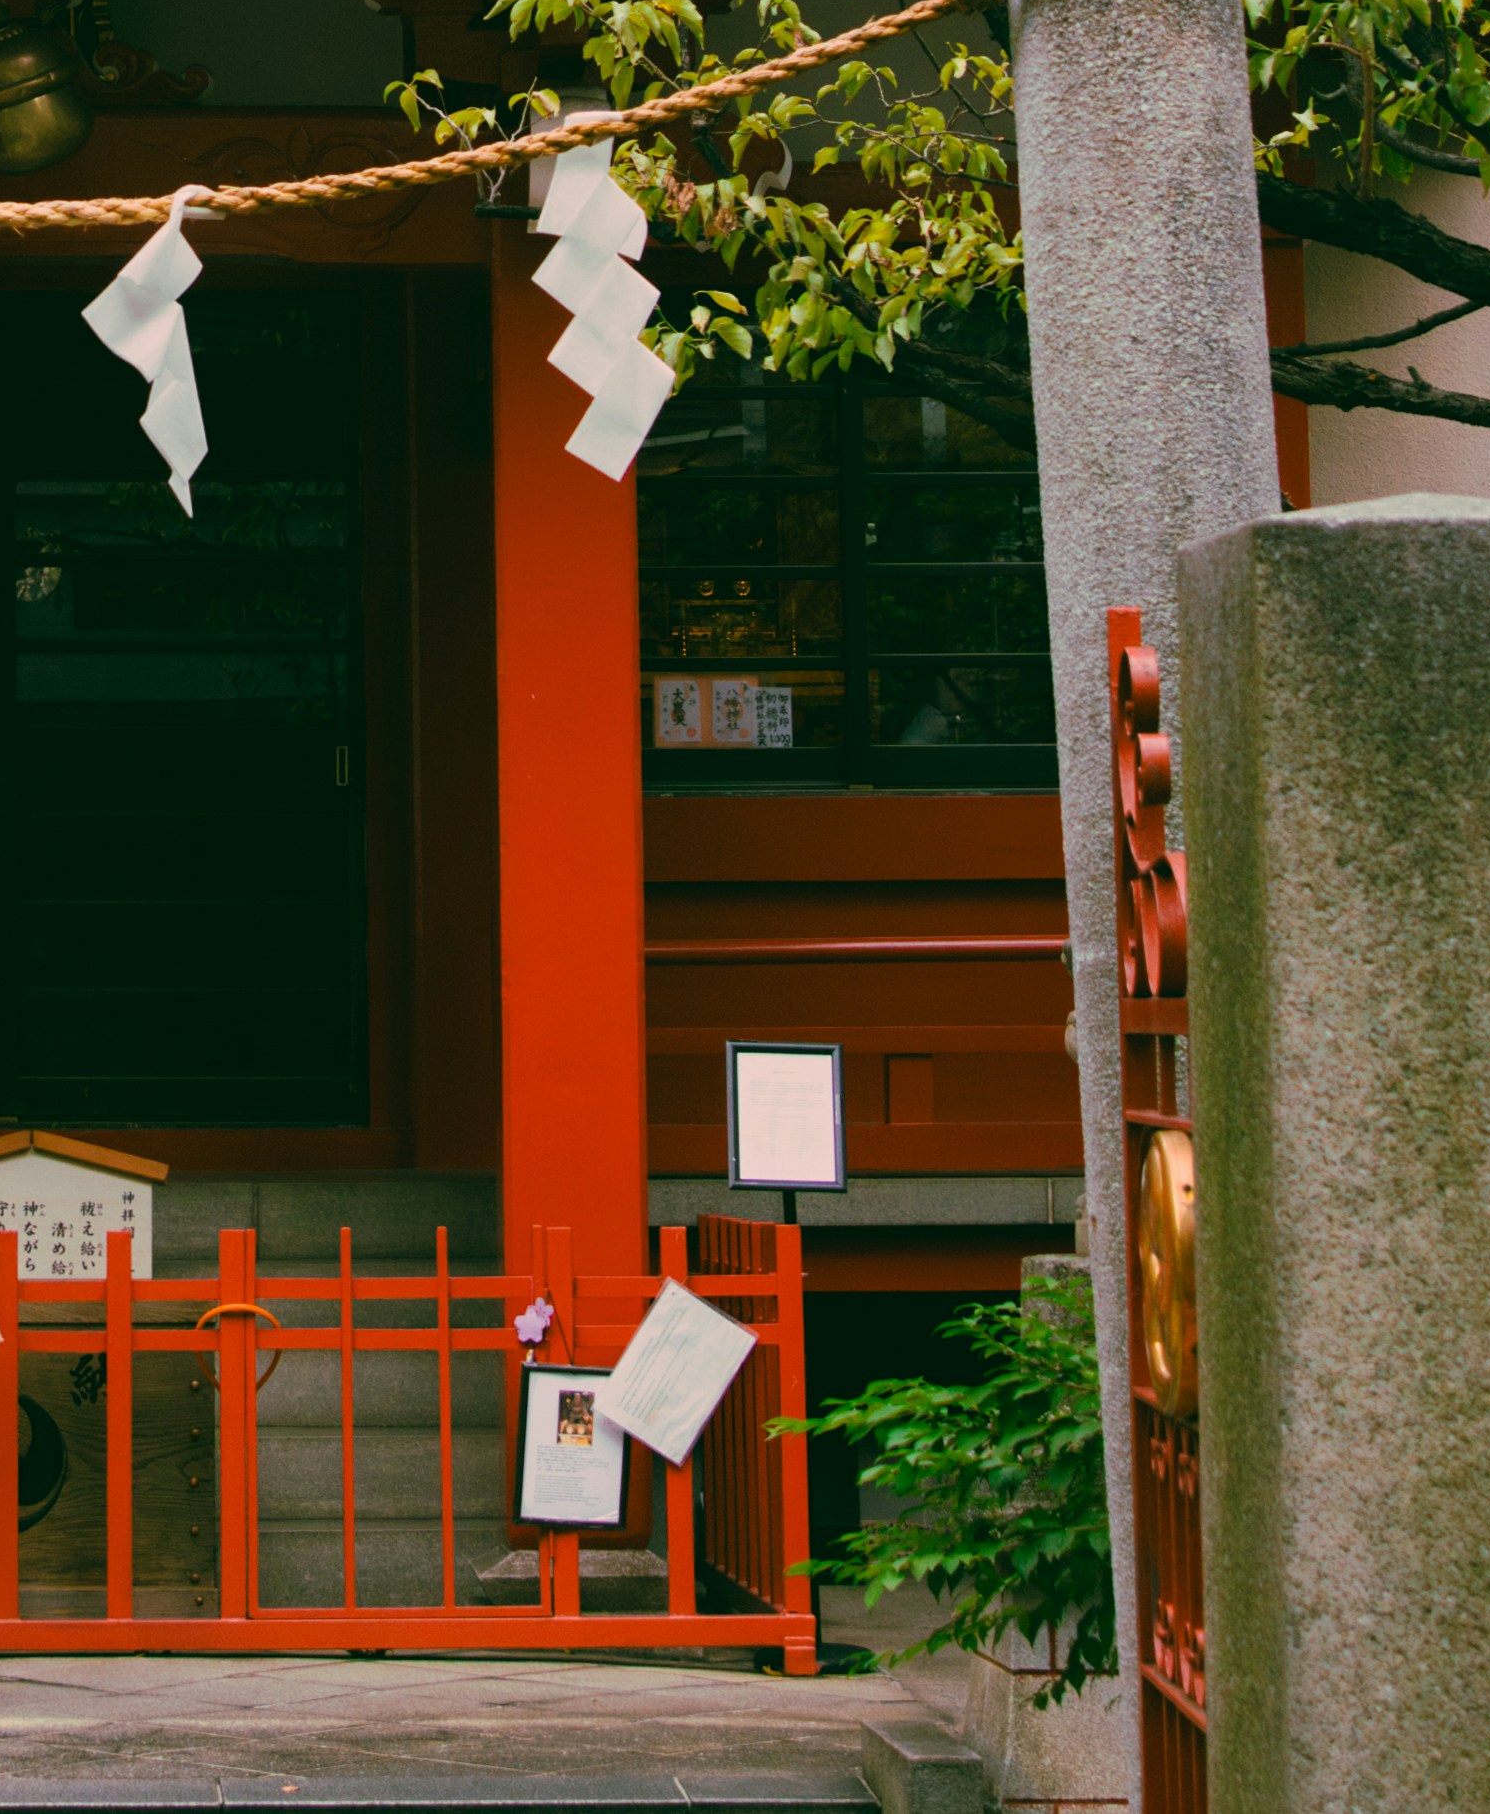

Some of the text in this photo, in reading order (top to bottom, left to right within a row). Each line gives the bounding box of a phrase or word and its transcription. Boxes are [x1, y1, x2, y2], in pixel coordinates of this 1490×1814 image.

[724, 688, 740, 730] 八幡神社
[23, 1201, 38, 1272] 神ながら
[80, 1201, 96, 1271] 祓え給い
